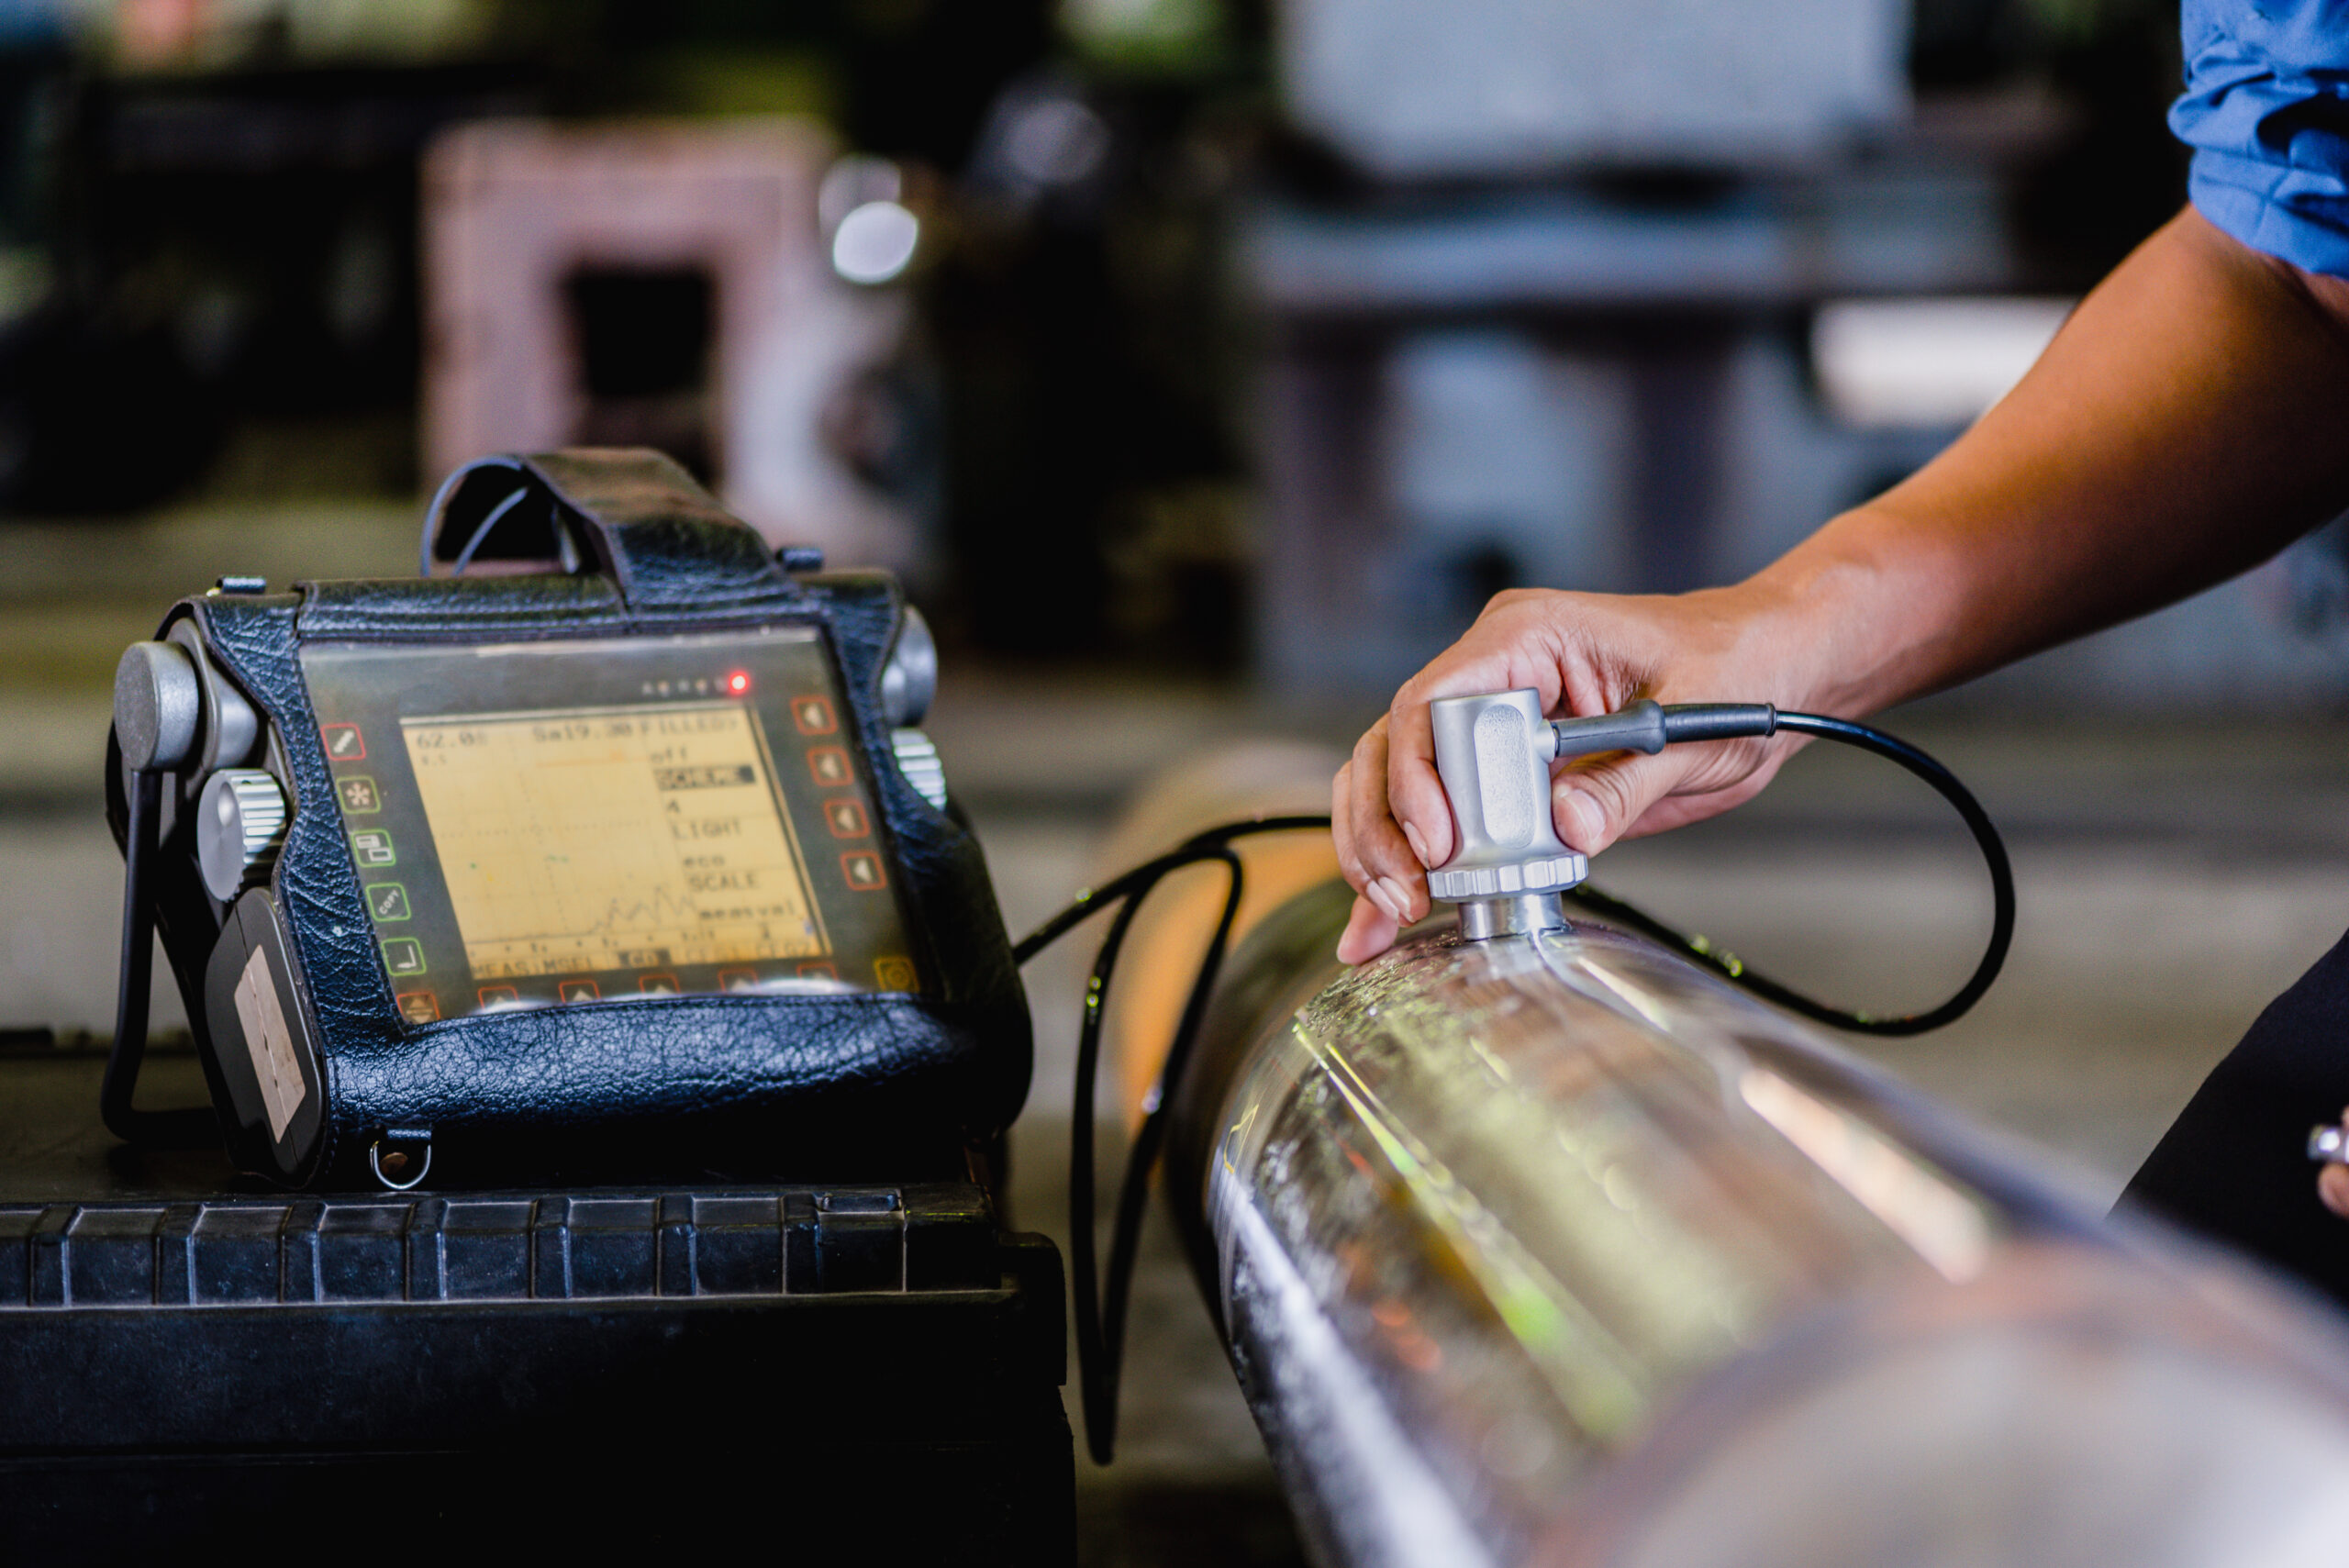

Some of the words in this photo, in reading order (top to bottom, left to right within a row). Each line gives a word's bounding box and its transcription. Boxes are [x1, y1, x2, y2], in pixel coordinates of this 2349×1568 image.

[671, 817, 742, 840] LIGHT
[689, 871, 761, 893] SCALE
[379, 890, 399, 916] COPY
